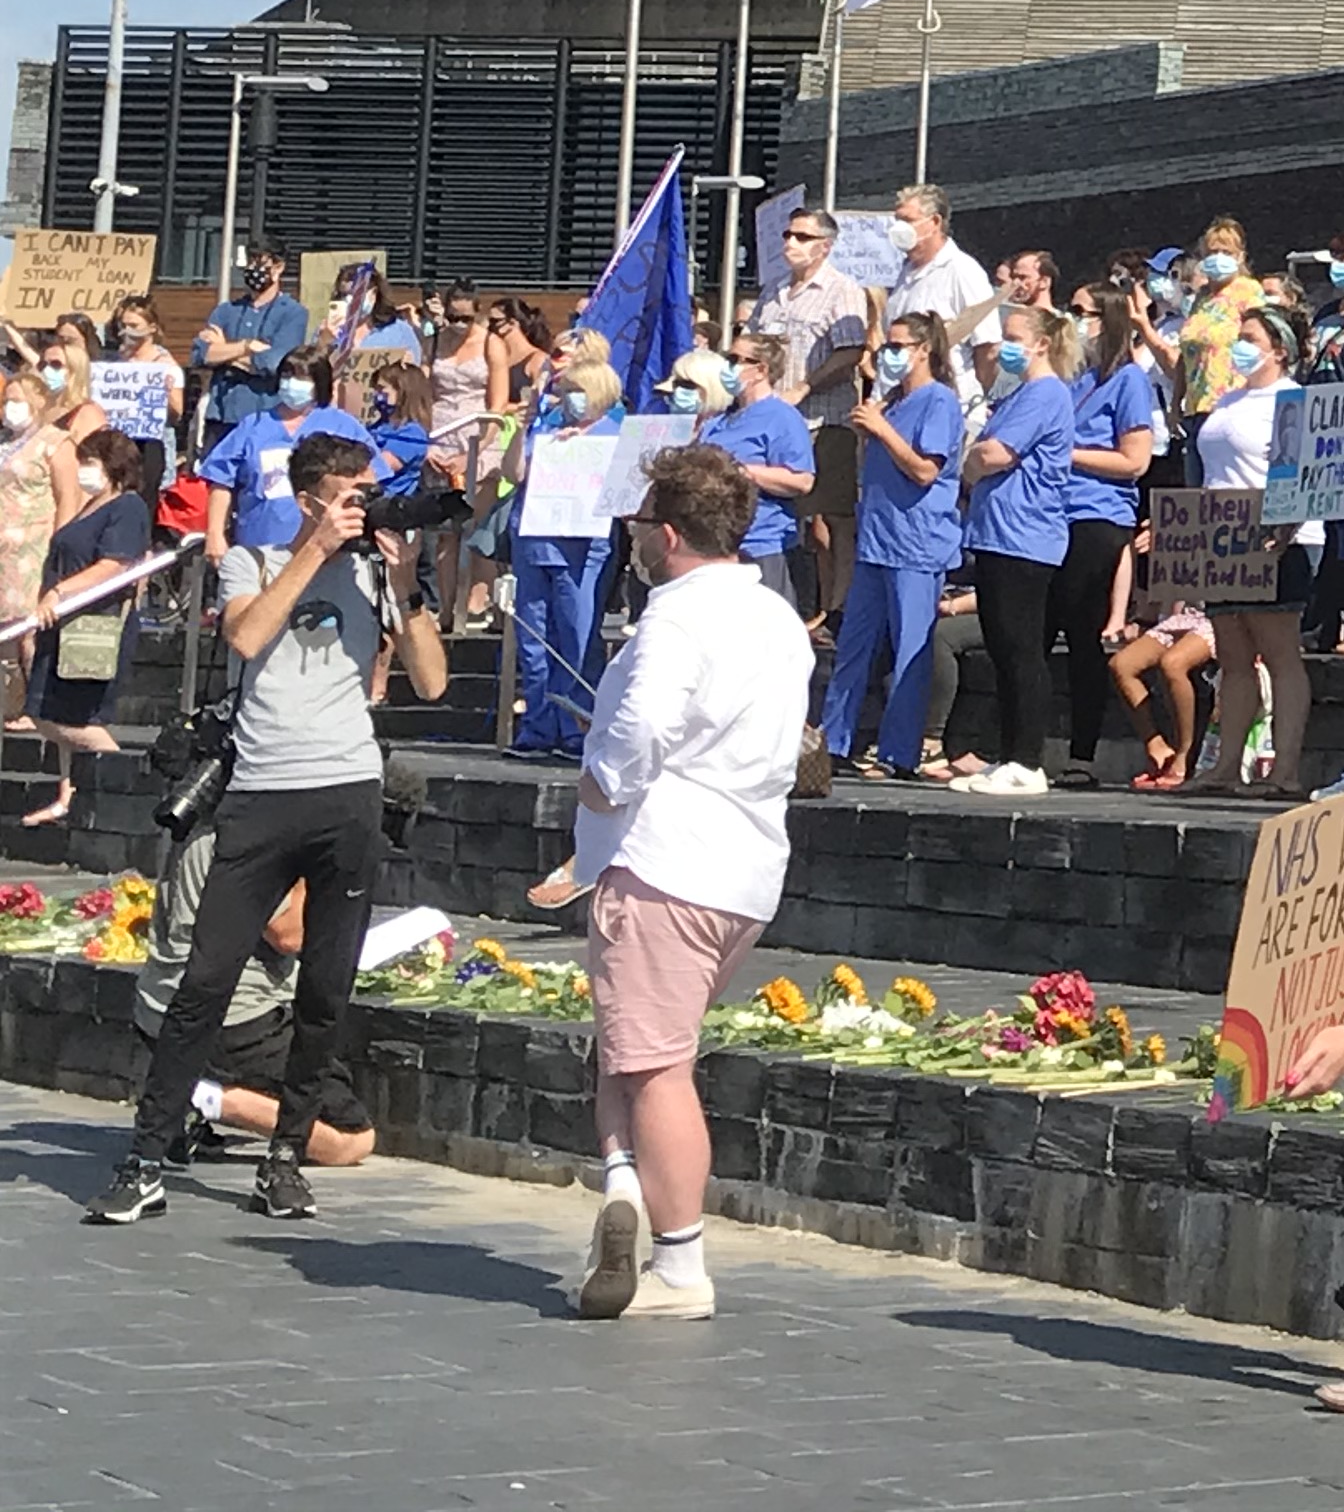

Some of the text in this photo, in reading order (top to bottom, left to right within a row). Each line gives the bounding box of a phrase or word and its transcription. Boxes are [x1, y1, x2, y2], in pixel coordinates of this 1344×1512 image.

[23, 233, 38, 251] I
[113, 237, 149, 257] PAY
[85, 257, 110, 269] MY
[22, 269, 136, 285] STUDENT LOAN
[15, 287, 55, 309] IN
[104, 369, 163, 385] GAVE US
[1300, 466, 1325, 493] PAY
[1160, 496, 1189, 528] Do
[1199, 493, 1251, 530] they
[1306, 491, 1343, 520] RENT
[1172, 561, 1199, 588] the
[1262, 810, 1331, 904] NHS
[1252, 897, 1304, 970] ARE
[1269, 951, 1323, 1032] NOT
